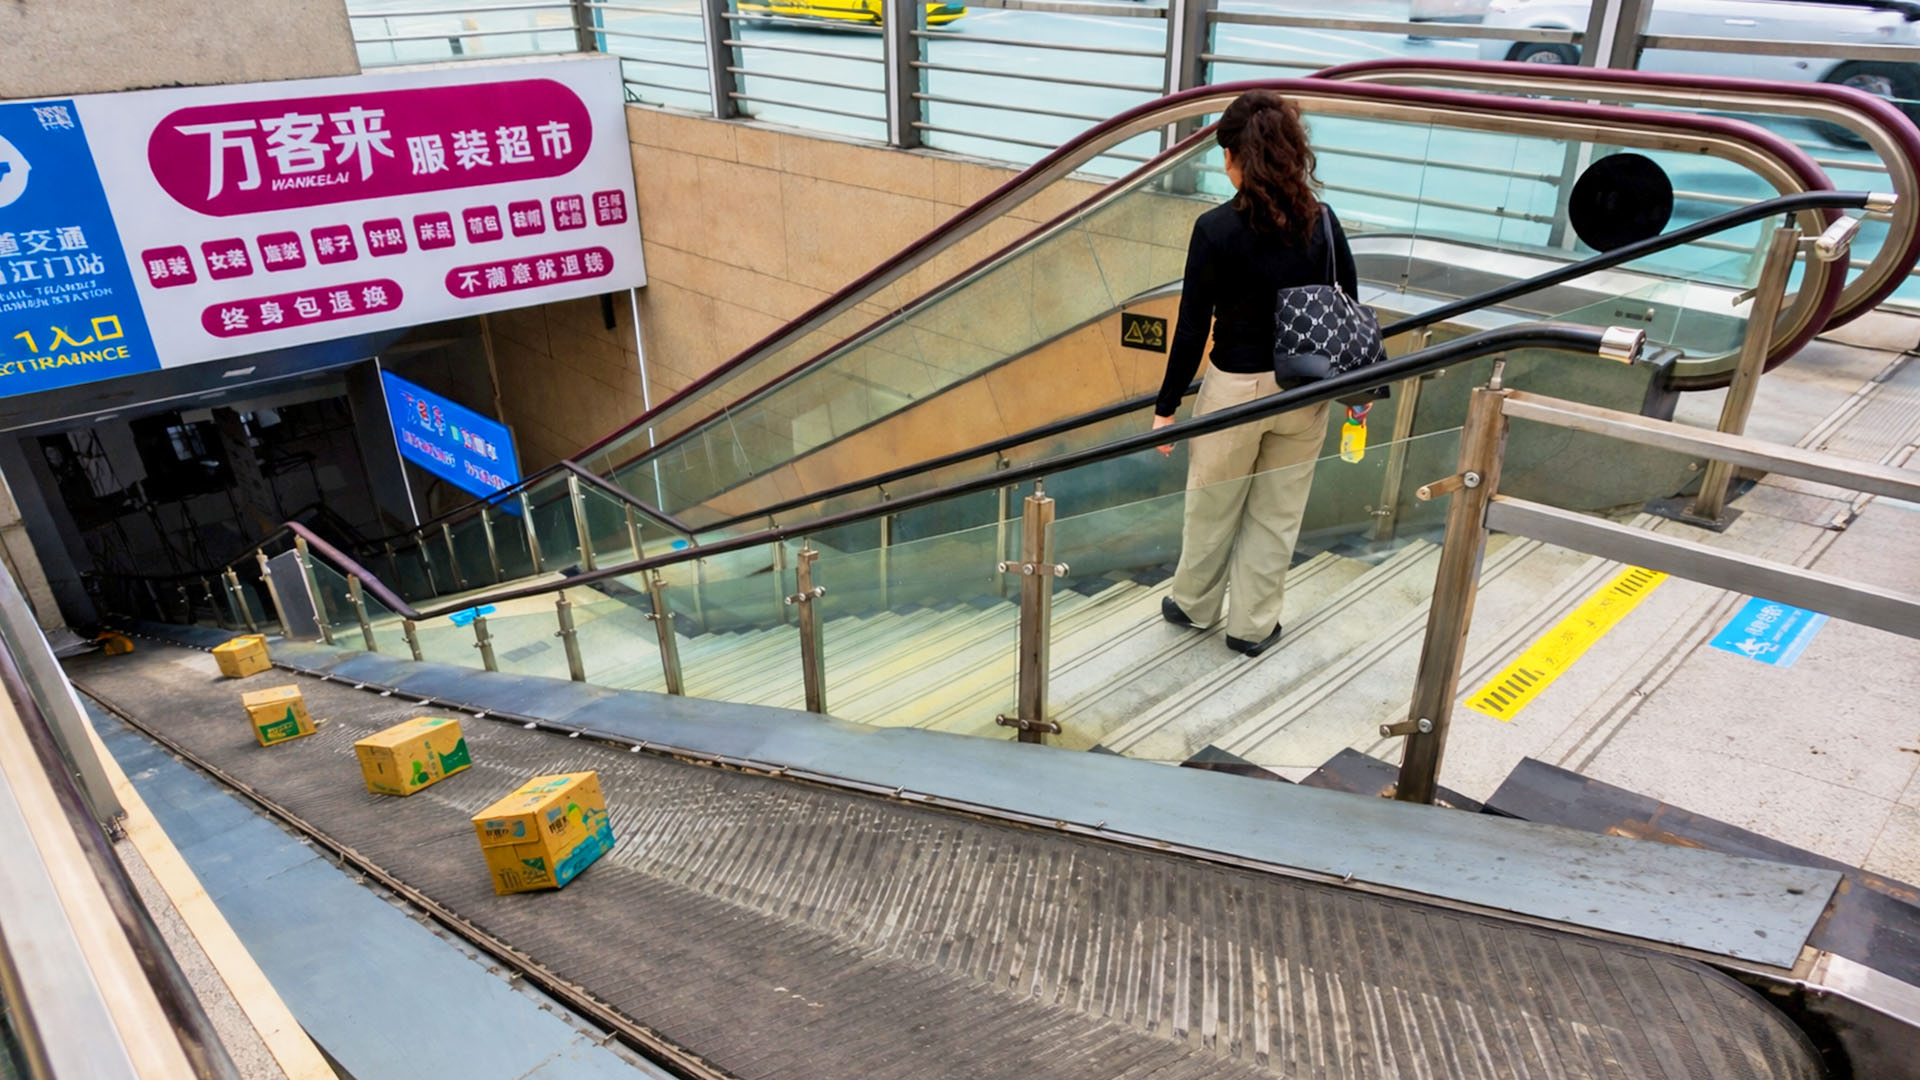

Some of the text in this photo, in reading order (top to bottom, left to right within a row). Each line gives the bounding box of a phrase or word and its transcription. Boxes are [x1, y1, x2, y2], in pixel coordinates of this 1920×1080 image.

[173, 106, 573, 201] 万客来 服装超市
[0, 252, 105, 286] 江门站
[207, 248, 248, 271] 女装
